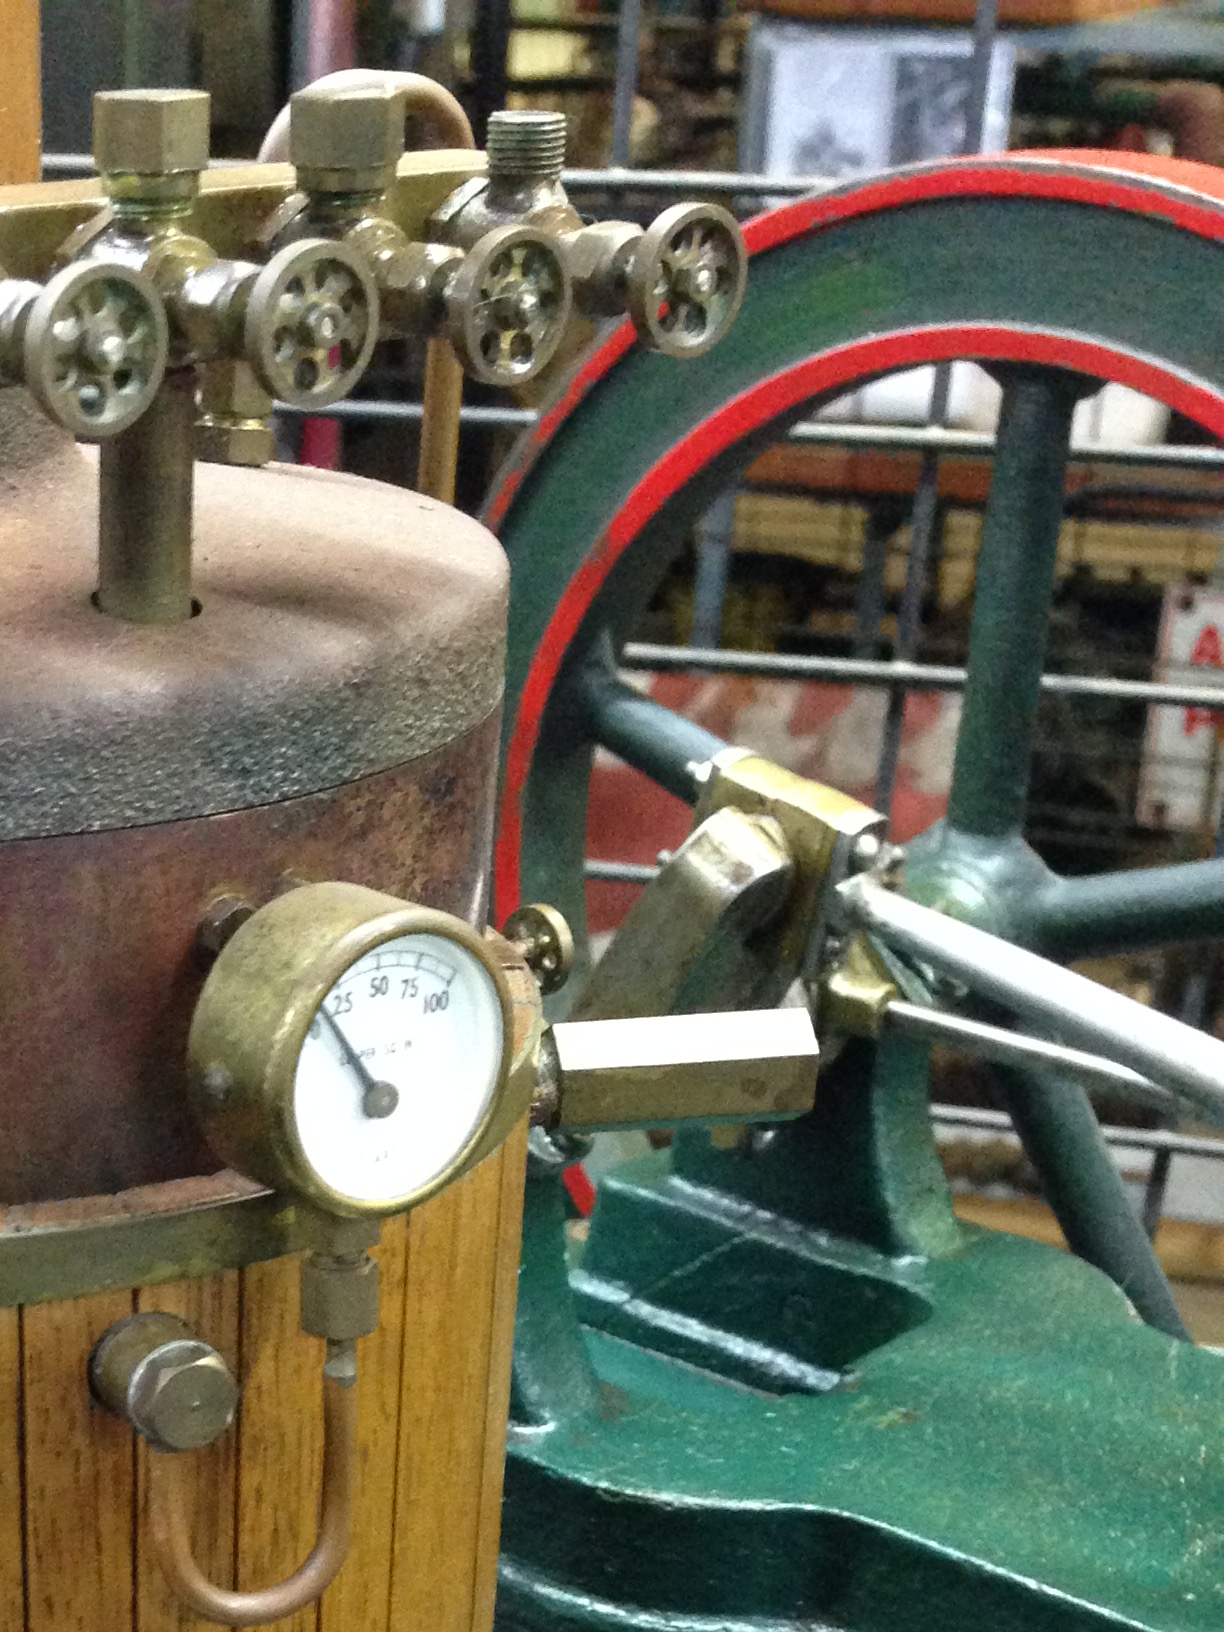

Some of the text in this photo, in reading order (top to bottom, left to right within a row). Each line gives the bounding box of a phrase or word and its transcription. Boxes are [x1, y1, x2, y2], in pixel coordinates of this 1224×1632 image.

[333, 991, 353, 1016] 25
[369, 975, 389, 998] 50
[401, 976, 419, 999] 75
[423, 990, 450, 1014] 100
